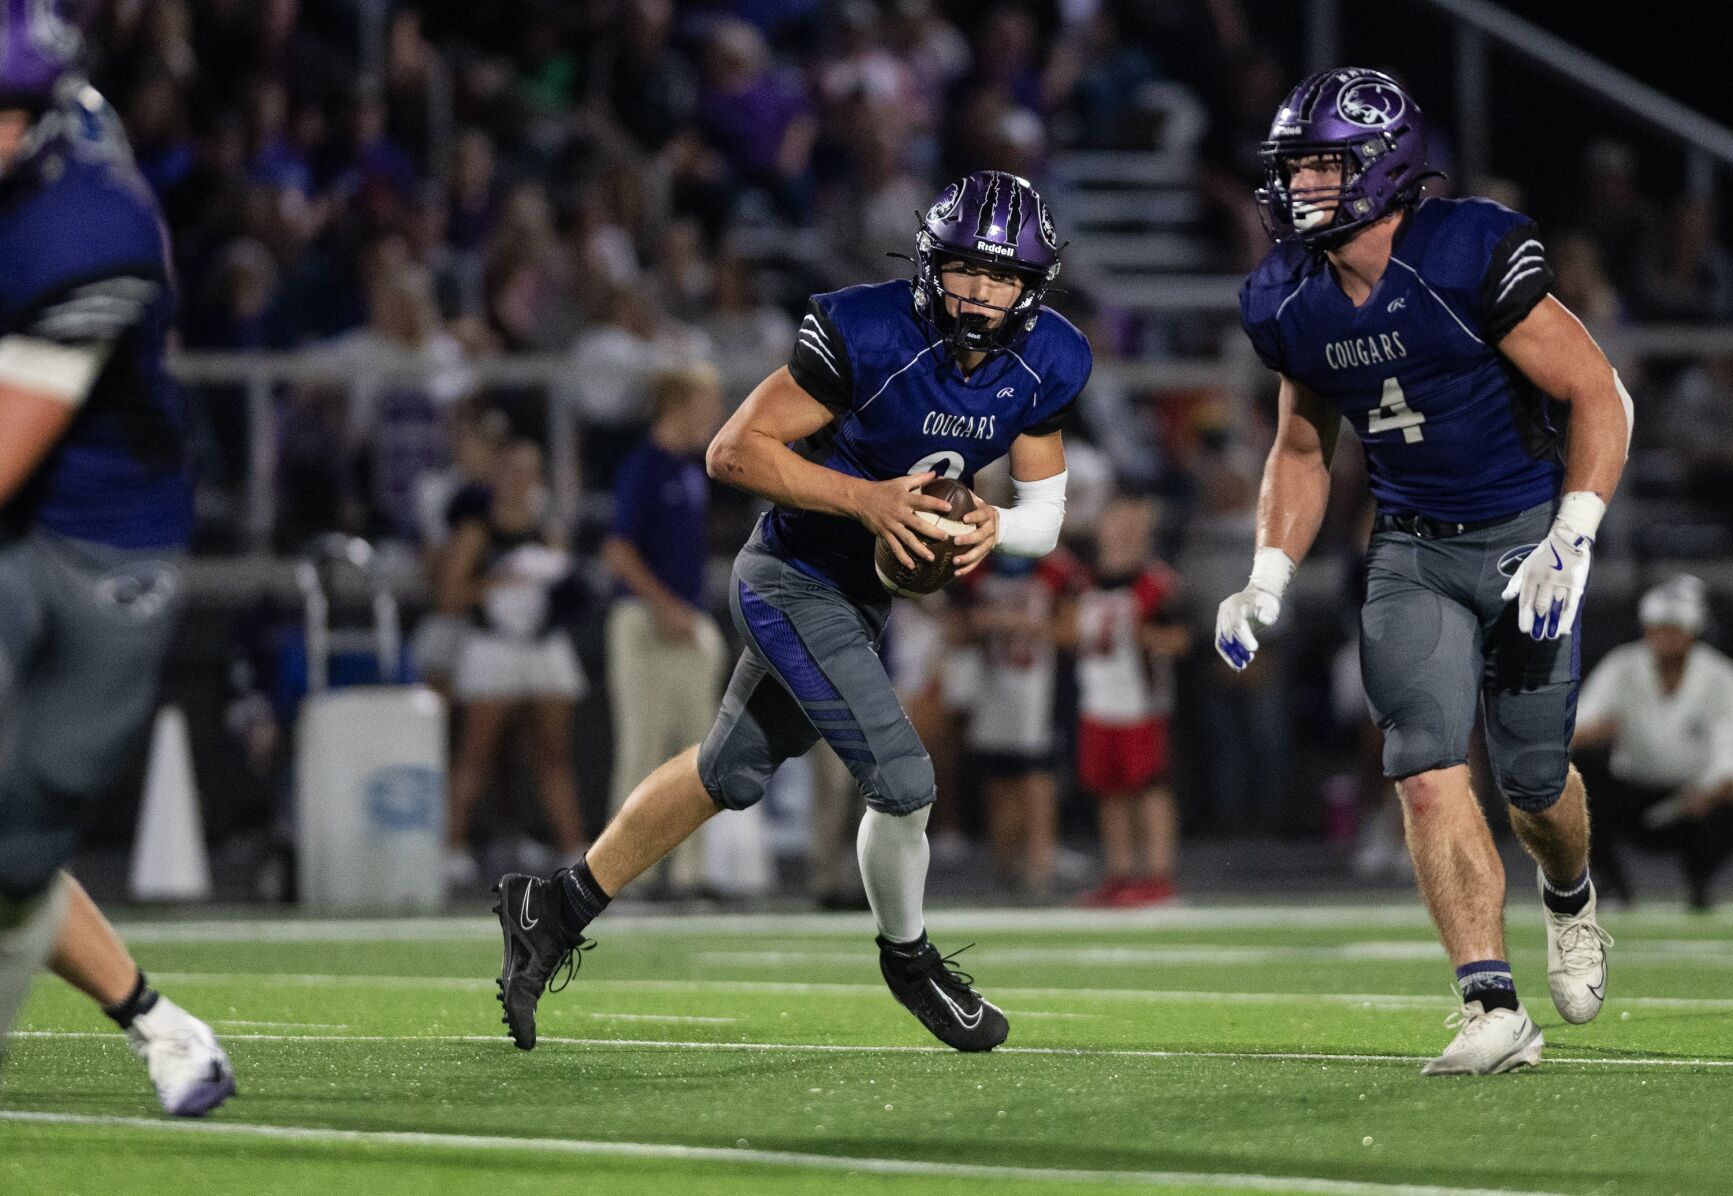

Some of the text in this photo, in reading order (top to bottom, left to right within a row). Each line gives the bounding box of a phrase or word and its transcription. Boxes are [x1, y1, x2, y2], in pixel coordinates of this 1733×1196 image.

[977, 240, 1015, 257] Riddell
[1325, 331, 1407, 370] COUGARS
[922, 410, 996, 440] COUGARS
[1368, 376, 1426, 445] 4
